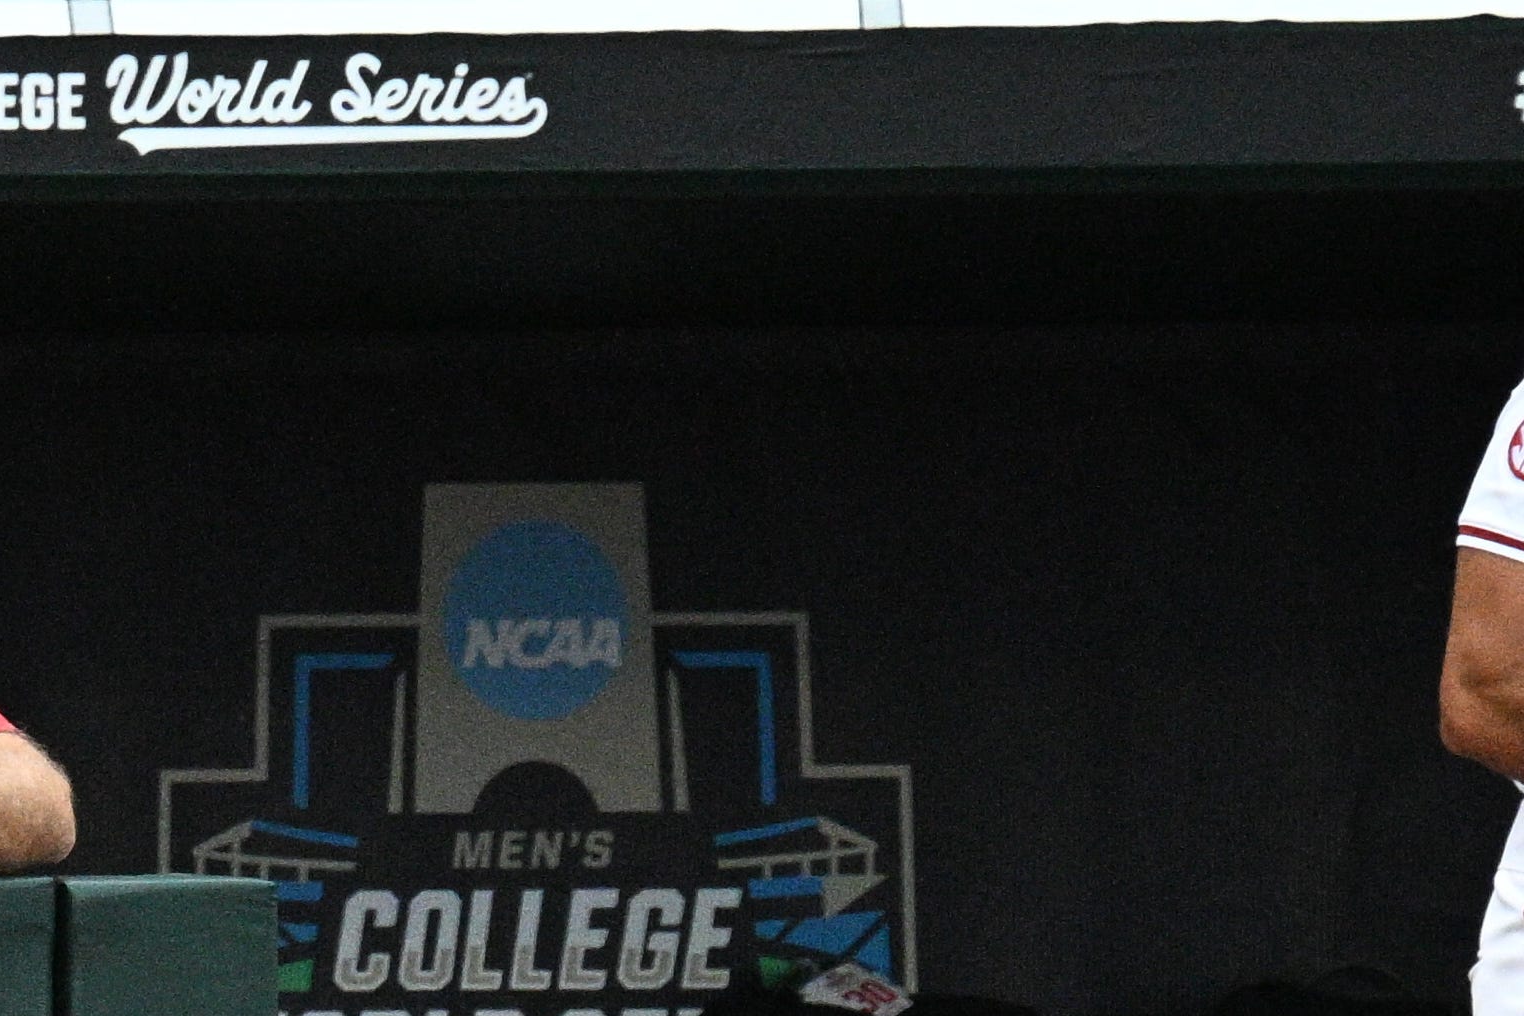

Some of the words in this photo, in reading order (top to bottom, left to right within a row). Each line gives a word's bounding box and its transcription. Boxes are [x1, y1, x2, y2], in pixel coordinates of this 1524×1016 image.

[106, 52, 312, 125] World
[330, 53, 528, 123] Series
[461, 618, 623, 669] NCAA
[452, 830, 615, 870] MEN'S
[332, 888, 743, 993] COLLEGE
